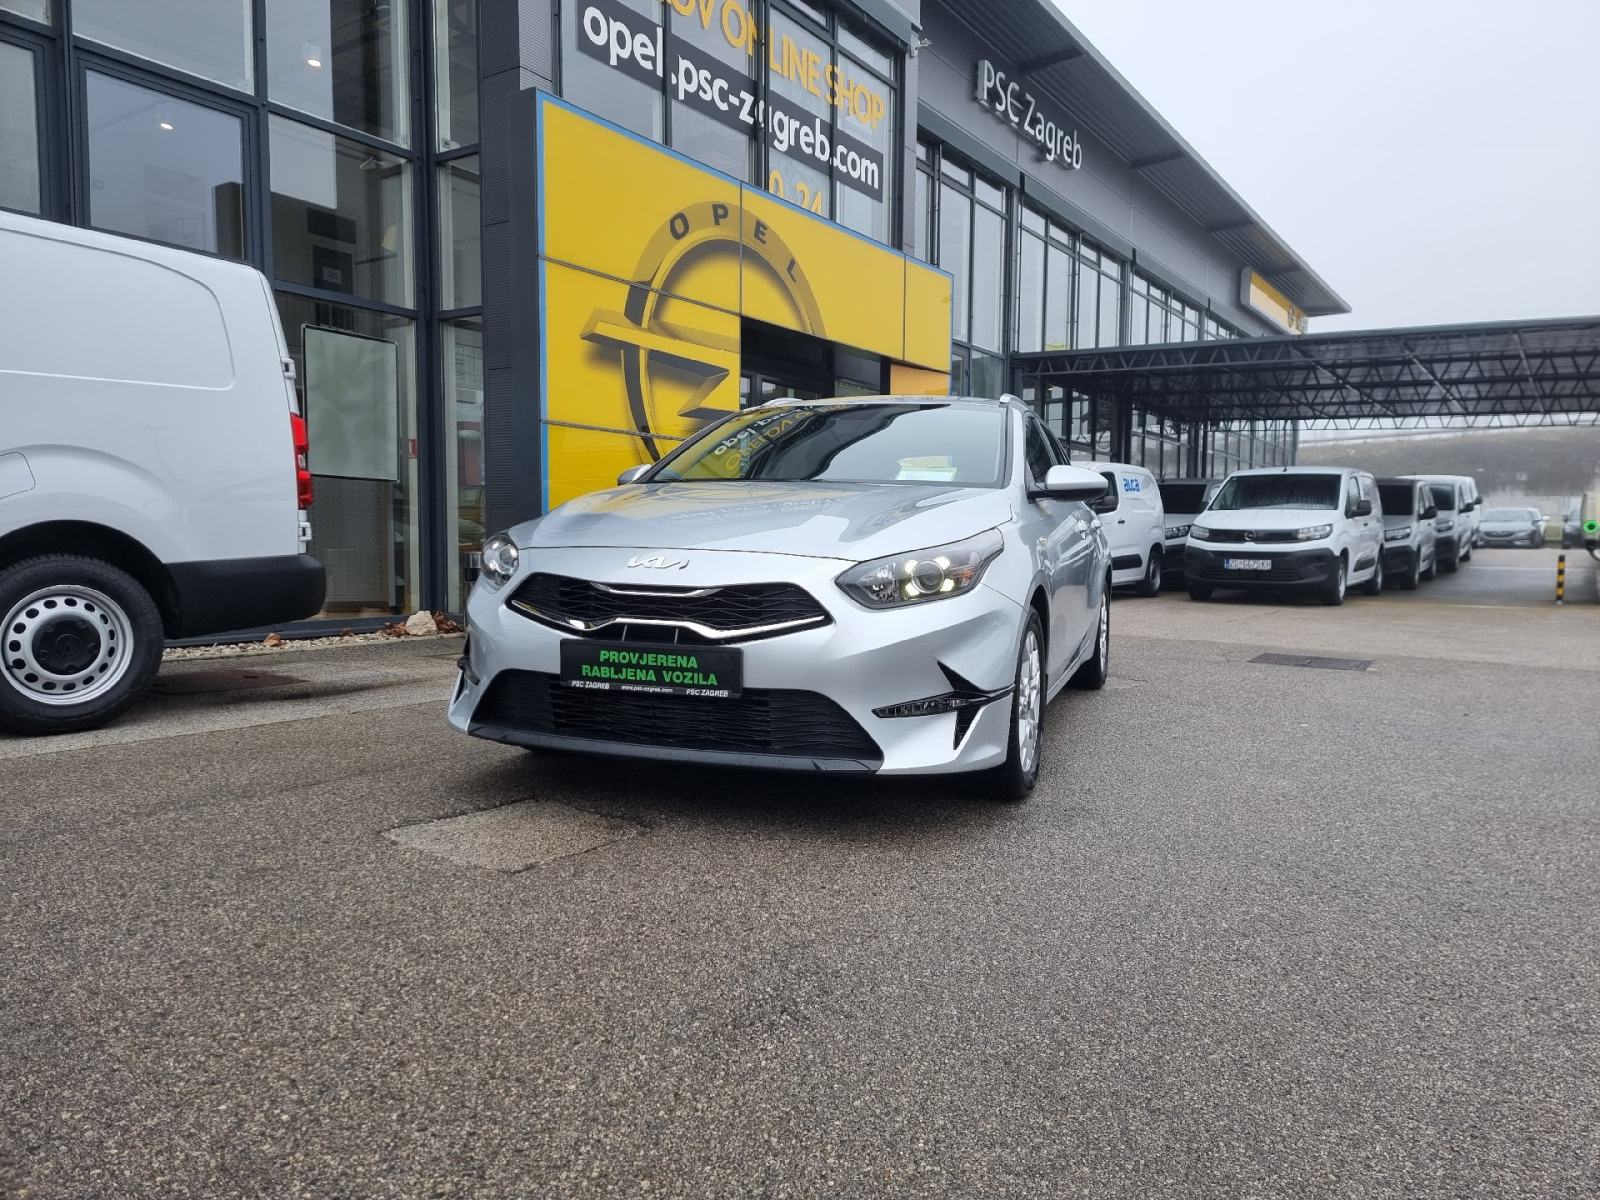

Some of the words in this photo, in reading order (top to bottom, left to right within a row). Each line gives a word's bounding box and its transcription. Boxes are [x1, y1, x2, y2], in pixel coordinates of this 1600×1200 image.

[825, 64, 884, 130] SHOP
[979, 60, 1082, 169] PSC-Zagreb
[670, 204, 797, 283] OPEL
[627, 556, 690, 570] KIA
[599, 650, 698, 669] PROVJERENA
[571, 680, 584, 688] PSC
[585, 682, 611, 690] ZAGREB
[581, 664, 656, 682] RABLJENA
[662, 670, 718, 686] VOZILA
[686, 688, 700, 696] PSC
[701, 689, 729, 698] ZAGREB
